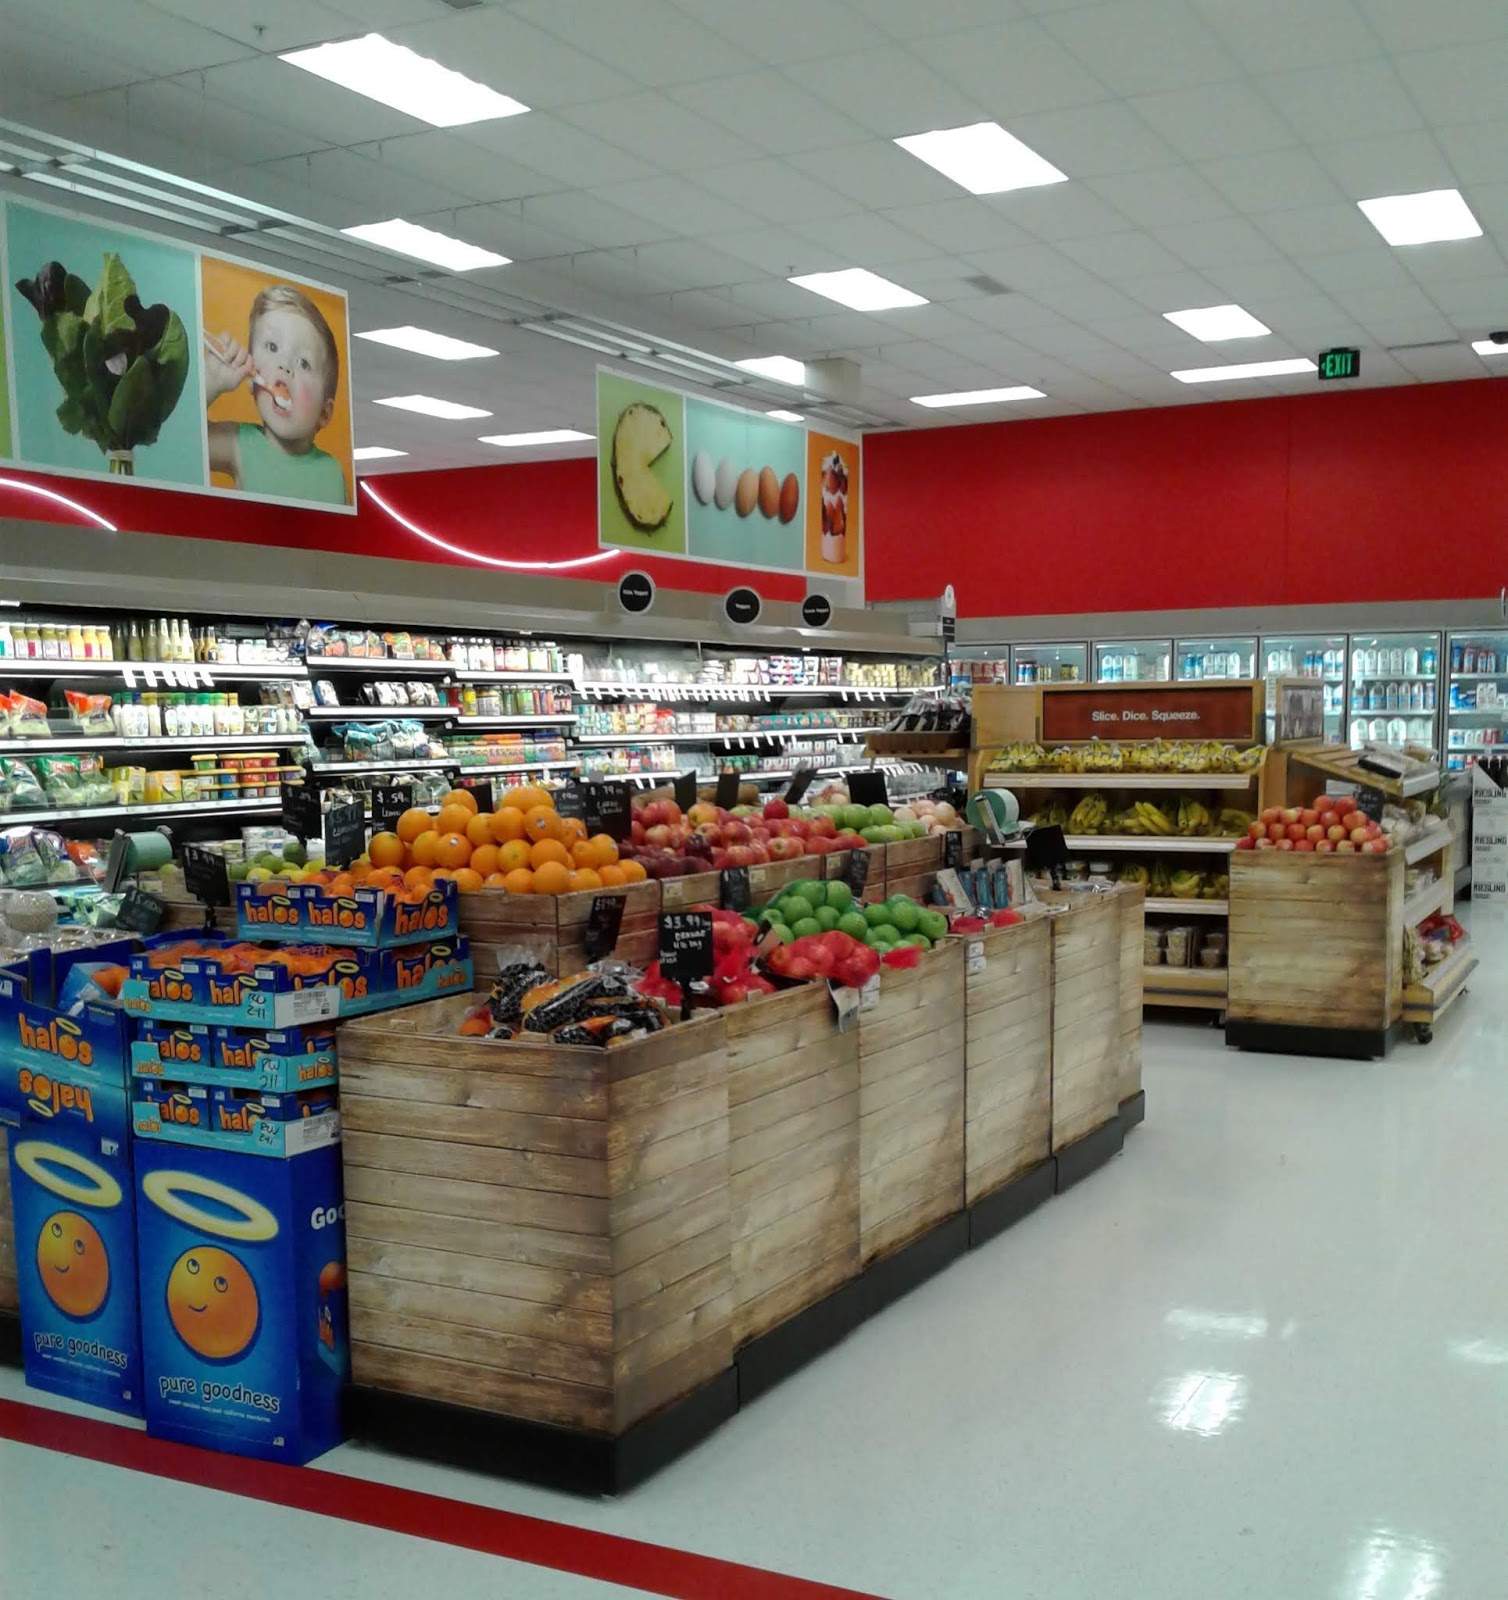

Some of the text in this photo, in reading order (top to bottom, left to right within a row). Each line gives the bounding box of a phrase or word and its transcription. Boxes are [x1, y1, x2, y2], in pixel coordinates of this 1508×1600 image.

[1326, 353, 1353, 376] EXIT
[1092, 709, 1200, 722] Slice. Dice. Squeeze.
[1474, 836, 1507, 845] RIESLING
[1473, 883, 1506, 892] RIESLING
[245, 900, 299, 925] halos
[308, 901, 366, 929] halos
[394, 902, 448, 936] halos
[138, 973, 193, 1001] alos
[210, 978, 248, 1006] hal
[19, 1012, 94, 1066] halos
[147, 1033, 201, 1062] alos
[298, 1063, 334, 1082] halos
[19, 1068, 94, 1122] halos
[147, 1096, 200, 1125] alos
[34, 1332, 64, 1353] pure
[68, 1337, 128, 1369] goodness
[159, 1376, 197, 1398] pure
[202, 1381, 280, 1413] goodness
